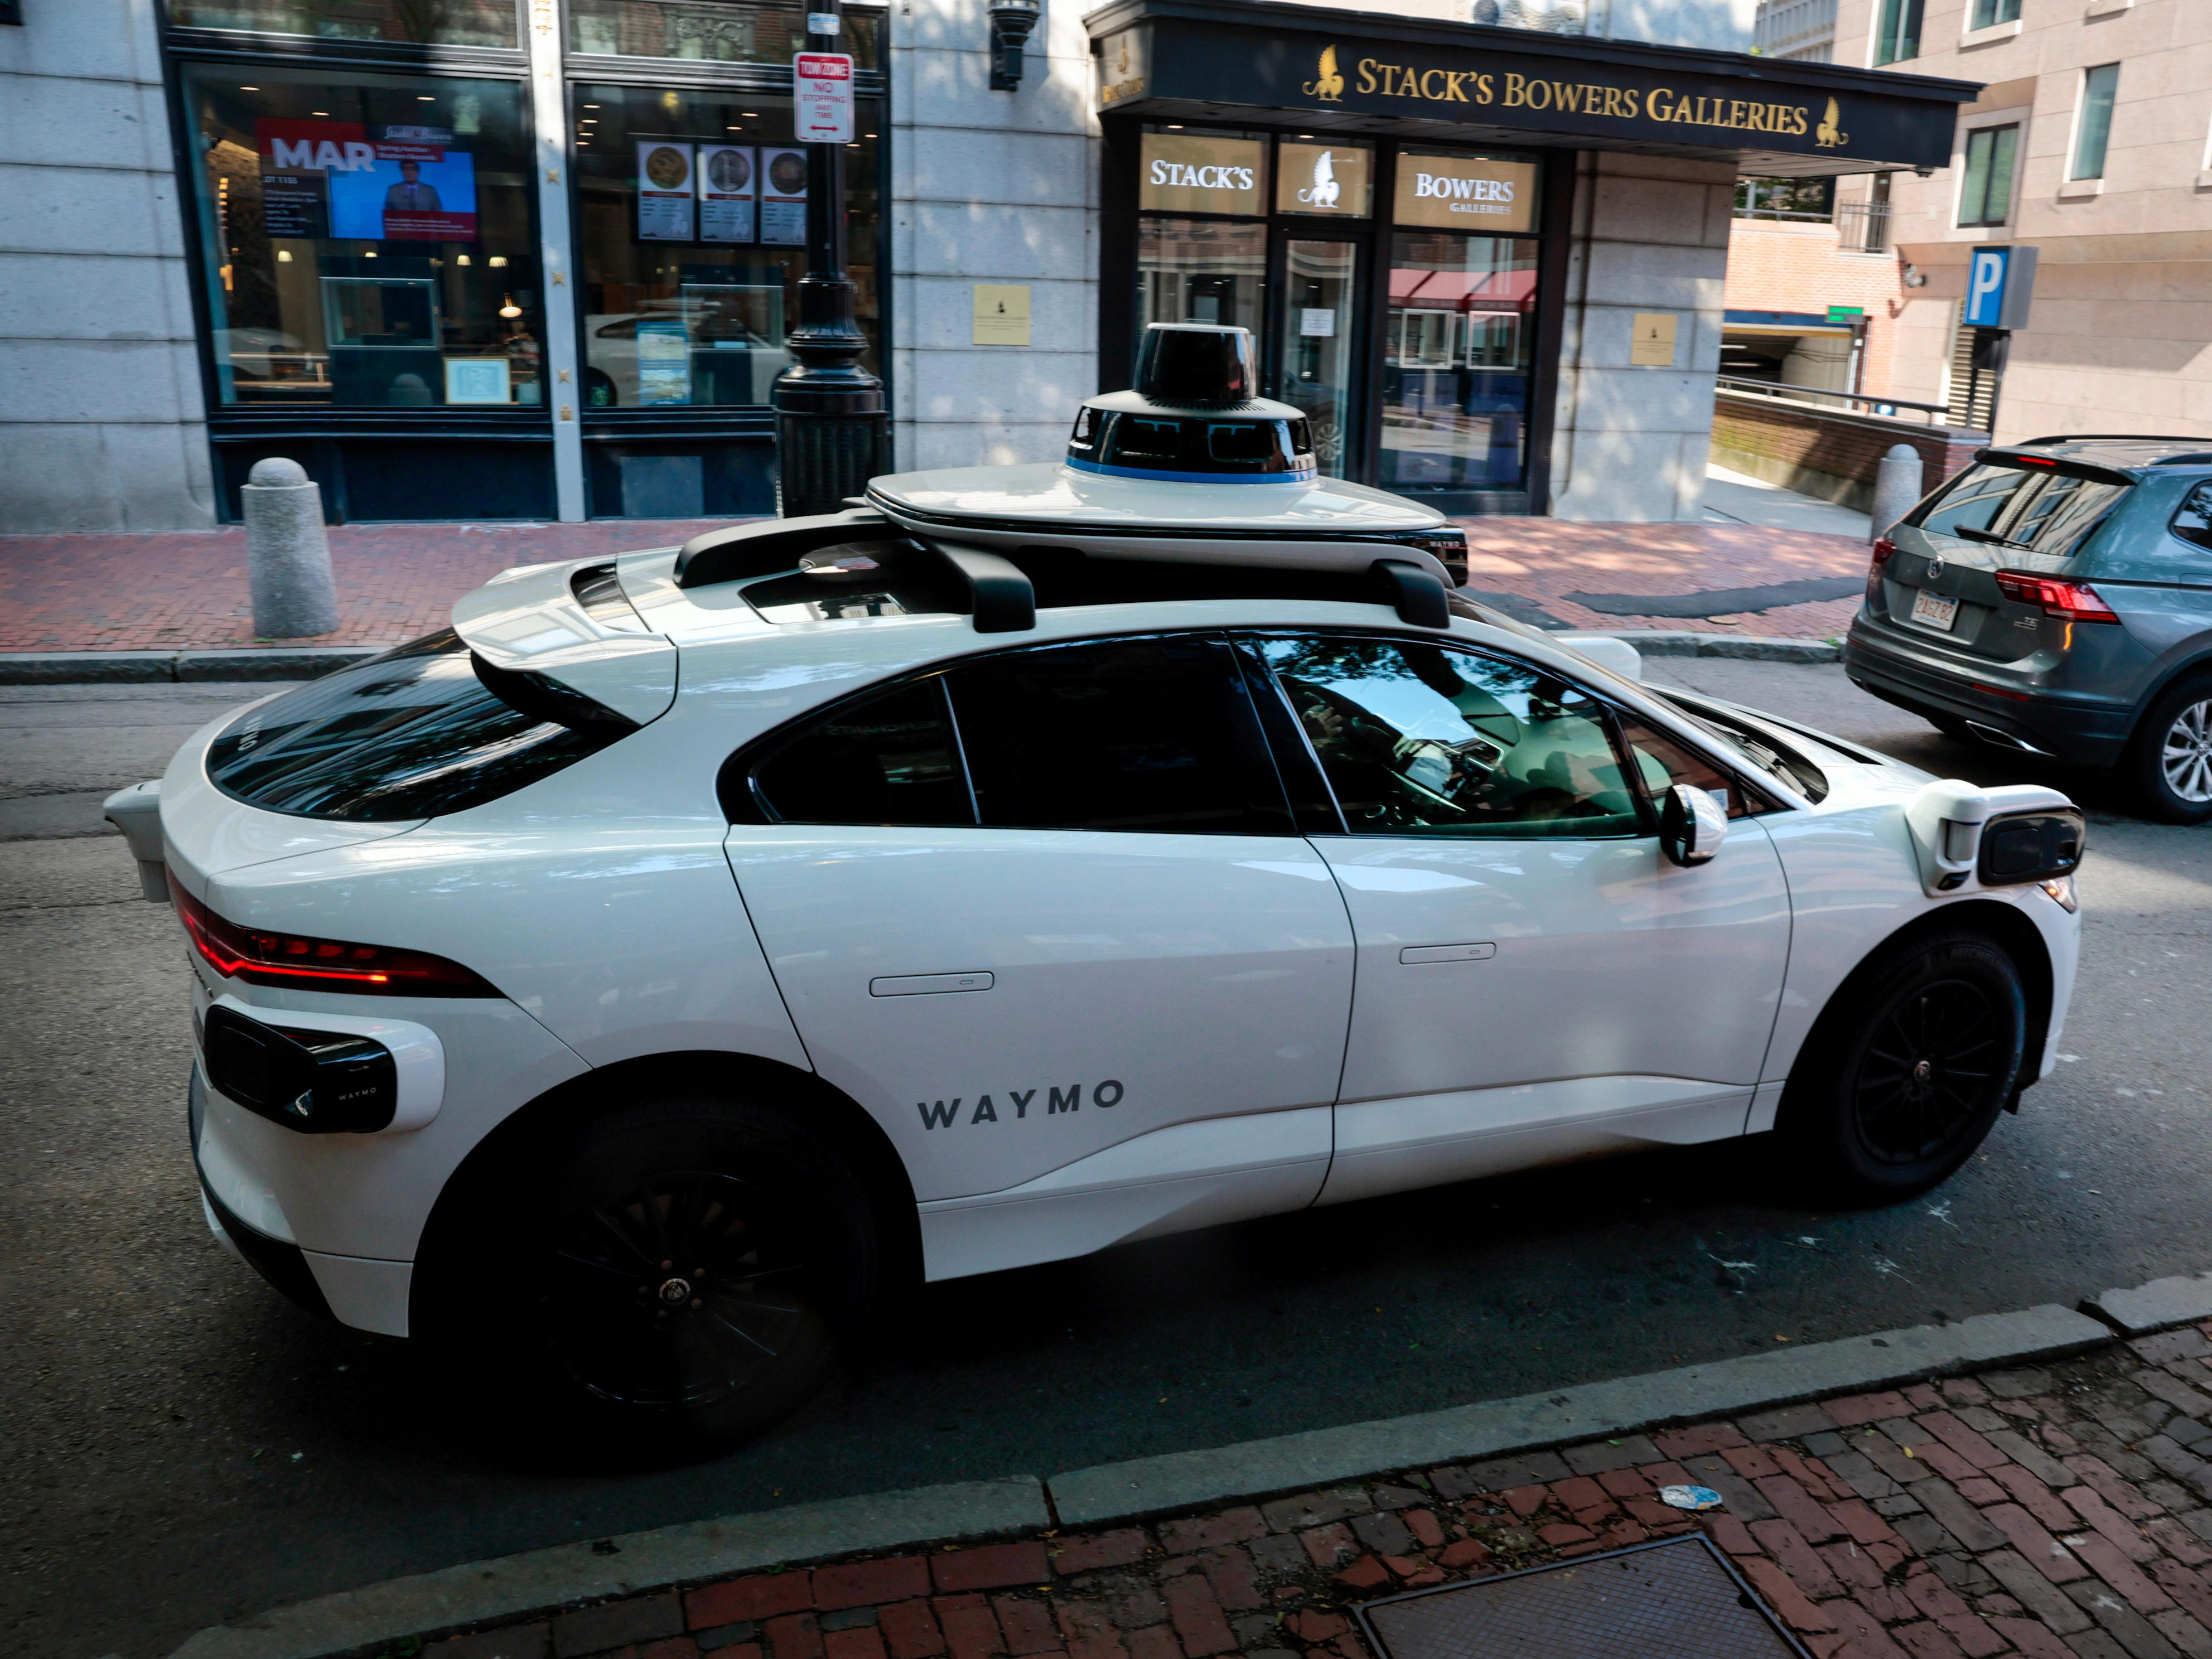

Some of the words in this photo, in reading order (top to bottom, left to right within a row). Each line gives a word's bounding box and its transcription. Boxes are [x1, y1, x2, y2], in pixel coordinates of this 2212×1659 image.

[800, 61, 820, 75] TOW
[820, 62, 848, 76] ZONE
[802, 94, 847, 103] STOPPING
[813, 82, 834, 93] NO
[1356, 58, 1494, 105] STACK'S
[1501, 72, 1639, 118] BOWERS
[1646, 88, 1809, 135] GALLERIES
[271, 138, 376, 172] MAR
[1150, 159, 1254, 190] STACK'S
[1414, 173, 1515, 202] BOWERS
[1449, 202, 1513, 215] GALLERIES
[1968, 253, 2003, 321] P
[338, 1087, 376, 1101] WAYMO
[916, 1079, 1124, 1130] WAYMO
